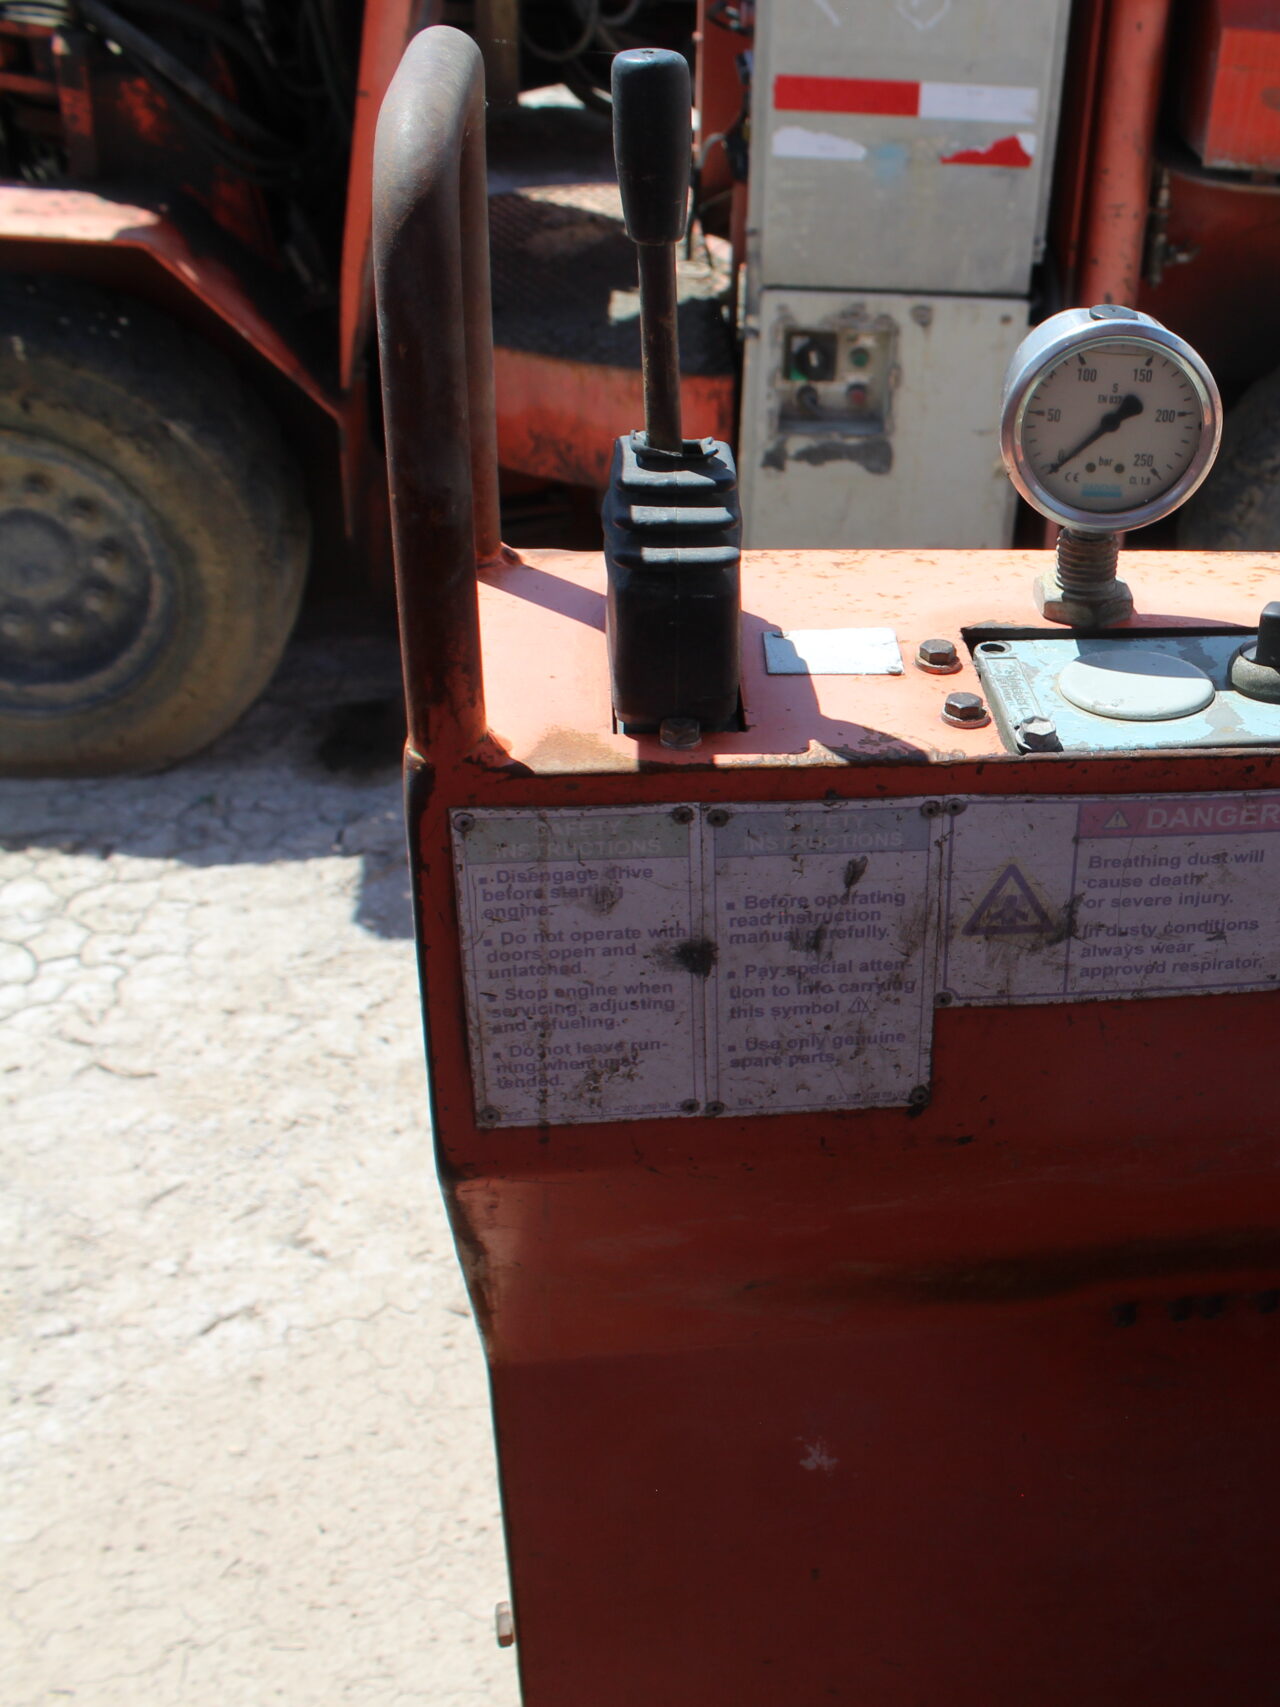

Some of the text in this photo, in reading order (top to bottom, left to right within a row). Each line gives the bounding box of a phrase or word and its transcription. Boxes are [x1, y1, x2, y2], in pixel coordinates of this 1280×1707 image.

[1077, 368, 1097, 382] 100
[1133, 369, 1152, 383] 150
[1112, 383, 1119, 393] S
[1047, 409, 1061, 422] 50
[1155, 409, 1175, 423] 200
[1098, 456, 1113, 467] bar
[1133, 454, 1153, 467] 250
[783, 814, 865, 830] SAFETY
[1146, 804, 1280, 830] DANGER
[534, 819, 622, 839] SAFETY
[496, 839, 662, 860] INSTRUCTIONS
[743, 832, 904, 851] INSTRUCTIONS
[1088, 849, 1265, 871] Breathing dust will
[496, 865, 654, 885] Disengage drive
[1087, 872, 1202, 890] cause death
[482, 885, 542, 902] before
[744, 890, 906, 910] Before operating
[1086, 890, 1235, 909] or severe injury.
[484, 903, 554, 921] engine.
[729, 909, 881, 928] read instruction
[500, 922, 687, 945] Do not operate with
[729, 929, 800, 944] manual
[1082, 918, 1259, 940] In dusty conditions
[487, 943, 637, 963] doors open and
[1081, 940, 1195, 959] always wear
[488, 963, 587, 980] unlatched.
[744, 958, 913, 981] Pay special atten-
[1080, 959, 1166, 979] approved
[505, 981, 673, 1003] Stop engine when
[729, 984, 765, 999] tion
[772, 982, 790, 997] to
[589, 997, 675, 1015] adjusting
[730, 1000, 840, 1019] this symbol
[492, 1016, 620, 1034] and refueling.
[509, 1039, 669, 1058] Do not leave run-
[745, 1031, 906, 1051] Use only genuine
[496, 1059, 536, 1075] ning
[543, 1055, 590, 1070] when
[729, 1055, 782, 1071] spare
[497, 1074, 565, 1089] tended.
